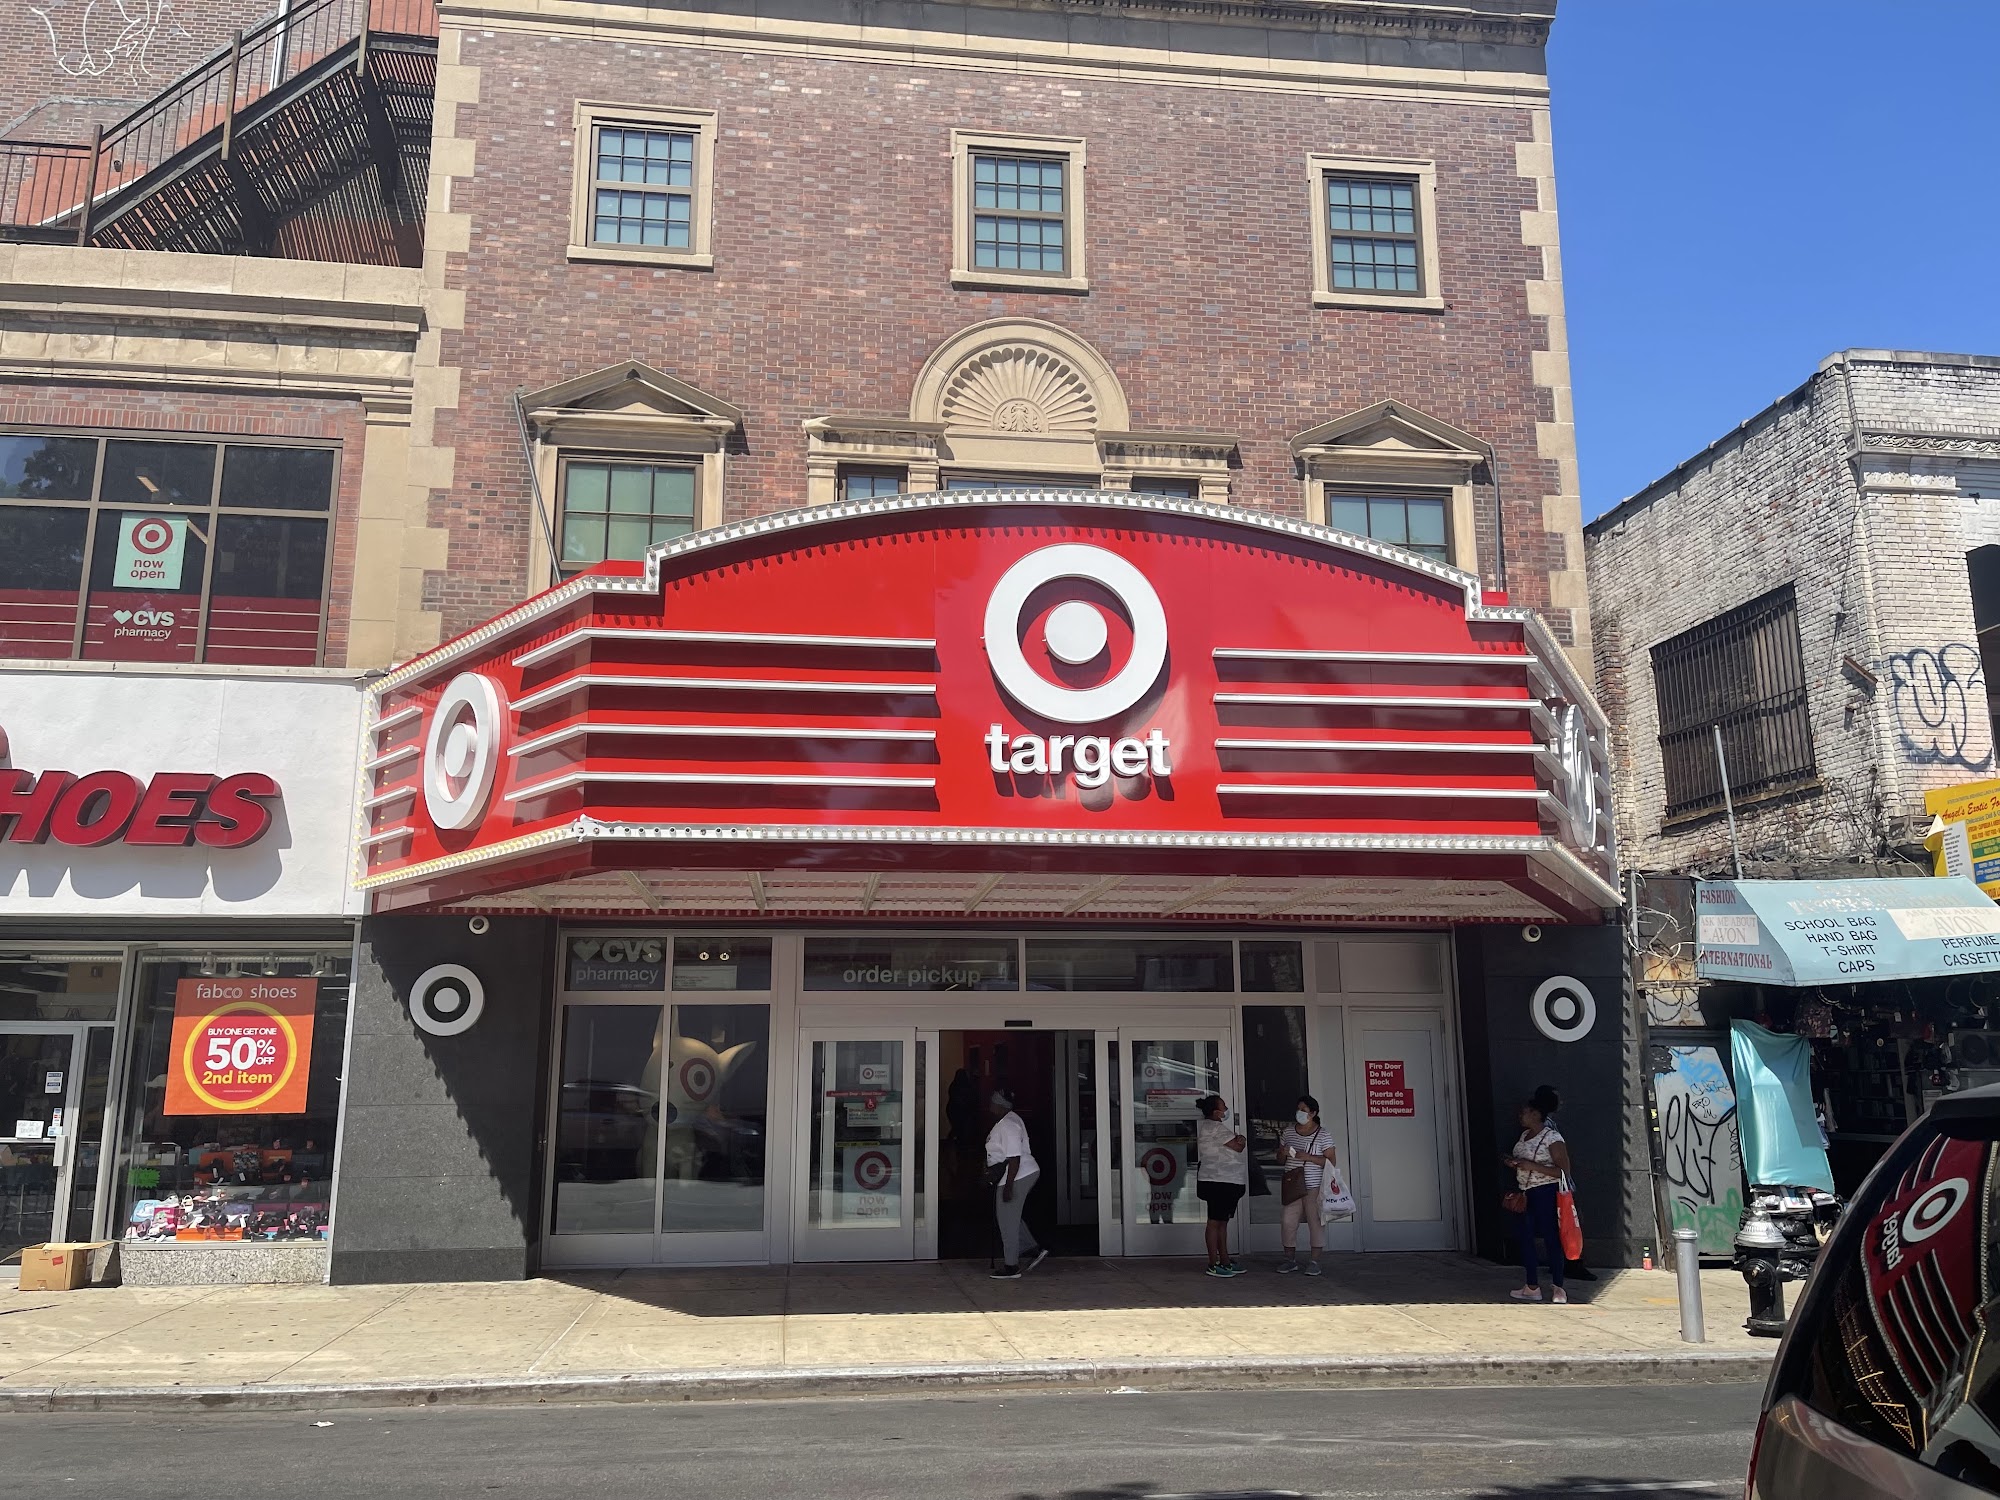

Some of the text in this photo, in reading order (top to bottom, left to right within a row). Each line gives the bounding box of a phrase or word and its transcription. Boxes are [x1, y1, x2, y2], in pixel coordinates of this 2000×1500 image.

[134, 559, 164, 568] now
[130, 569, 165, 580] open
[133, 610, 175, 627] CVS
[114, 627, 172, 640] pharmacy
[984, 722, 1172, 788] target
[1967, 802, 1988, 815] Exotic
[1700, 889, 1737, 904] FASHION
[1701, 916, 1757, 927] ASK ME ABOUT
[1784, 916, 1877, 931] SCHOOL BAG
[1933, 915, 1988, 936] AVON
[1712, 928, 1746, 943] AVON
[1805, 930, 1878, 943] HAND BAG
[1941, 935, 1999, 949] PERFUME
[601, 939, 663, 963] CVS
[1820, 944, 1876, 956] T-SHIRT
[1700, 950, 1773, 969] INTERNATIONAL
[1838, 959, 1875, 973] CAPS
[1943, 951, 2000, 967] CASSETT
[575, 965, 659, 984] pharmacy
[843, 964, 981, 987] order pickup
[196, 983, 297, 999] fabco shoes
[207, 1027, 277, 1036] BUY ONE GET ONE
[205, 1036, 276, 1070] 50% OFF
[1369, 1062, 1401, 1070] Fire Door
[202, 1069, 273, 1085] 2nd item
[1369, 1070, 1394, 1078] Do Not
[1370, 1090, 1404, 1098] Puerta de
[1370, 1106, 1413, 1115] No bloquear
[859, 1195, 887, 1205] now
[856, 1206, 889, 1218] open
